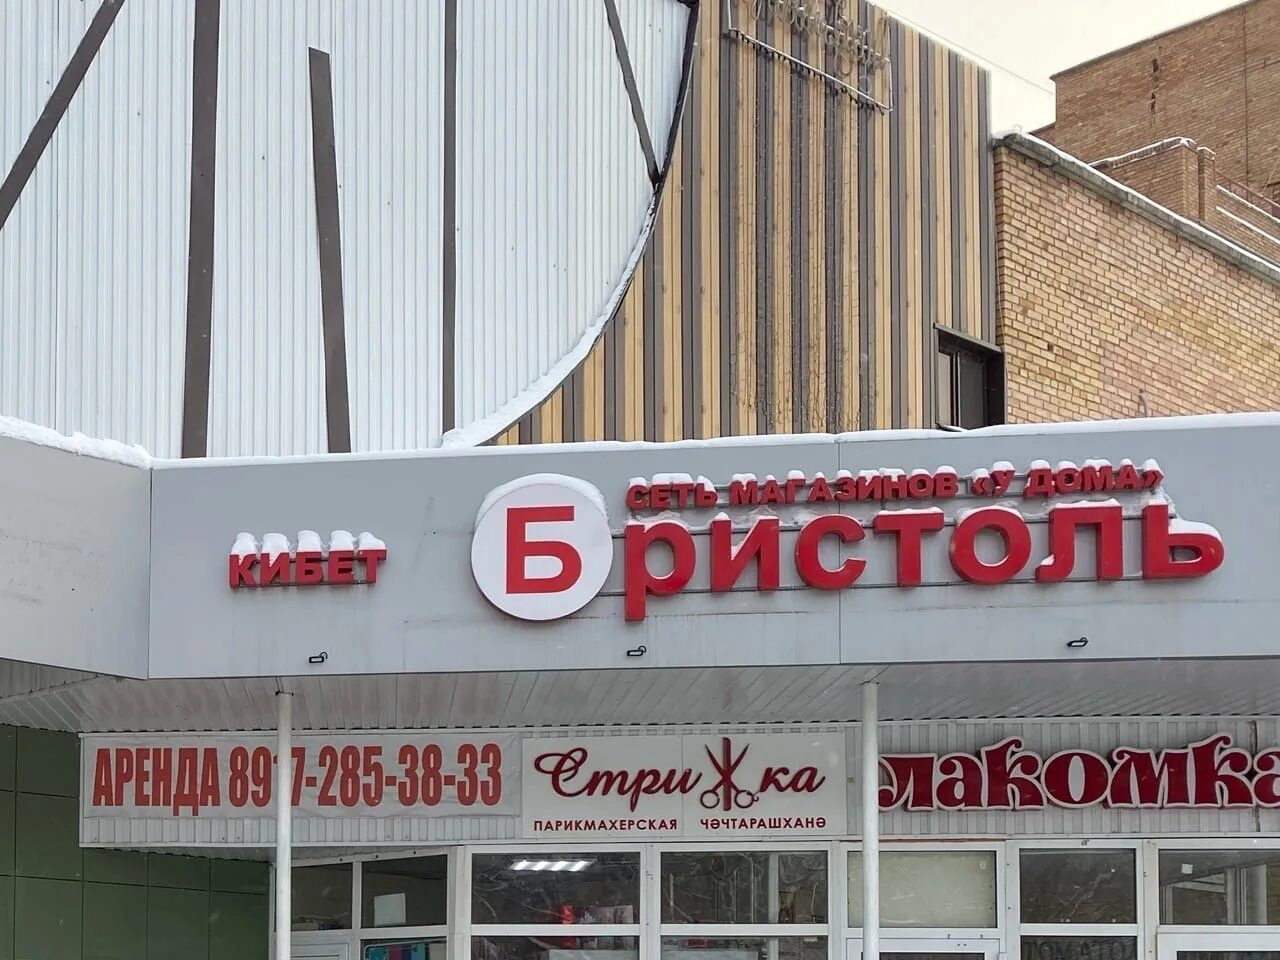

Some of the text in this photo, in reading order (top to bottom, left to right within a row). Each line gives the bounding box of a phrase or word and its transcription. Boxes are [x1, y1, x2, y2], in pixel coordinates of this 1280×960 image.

[626, 483, 719, 510] СЕТЬ
[729, 470, 960, 506] МАГАЗИНОВ
[229, 549, 388, 588] КИБЕТ
[505, 502, 1225, 622] Бристоль
[92, 743, 503, 816] АРЕНДА 897-285-38-33
[534, 818, 678, 832] ПАРИКМАХЕРСКАЯ
